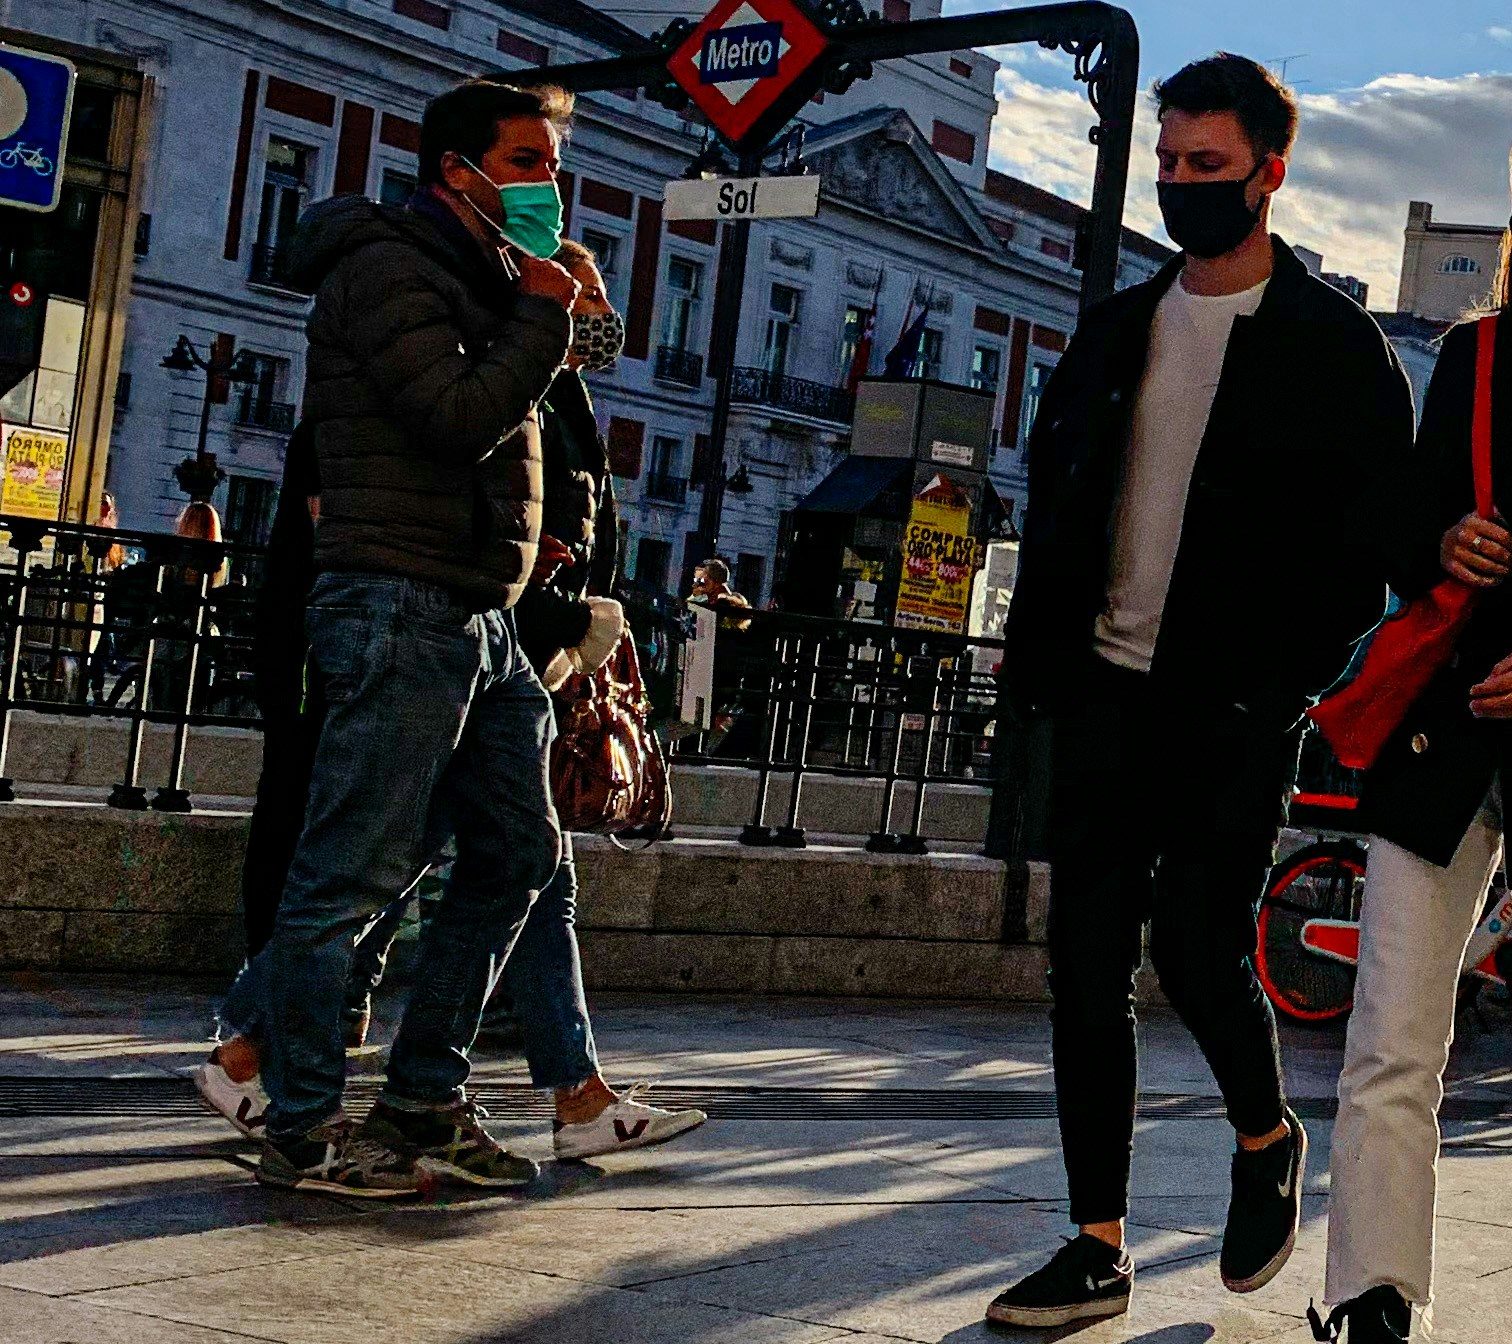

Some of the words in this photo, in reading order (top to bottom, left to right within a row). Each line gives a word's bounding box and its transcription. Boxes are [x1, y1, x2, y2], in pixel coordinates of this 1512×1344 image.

[706, 35, 773, 72] Metro
[717, 181, 758, 215] Sol
[910, 525, 974, 550] COMPRO
